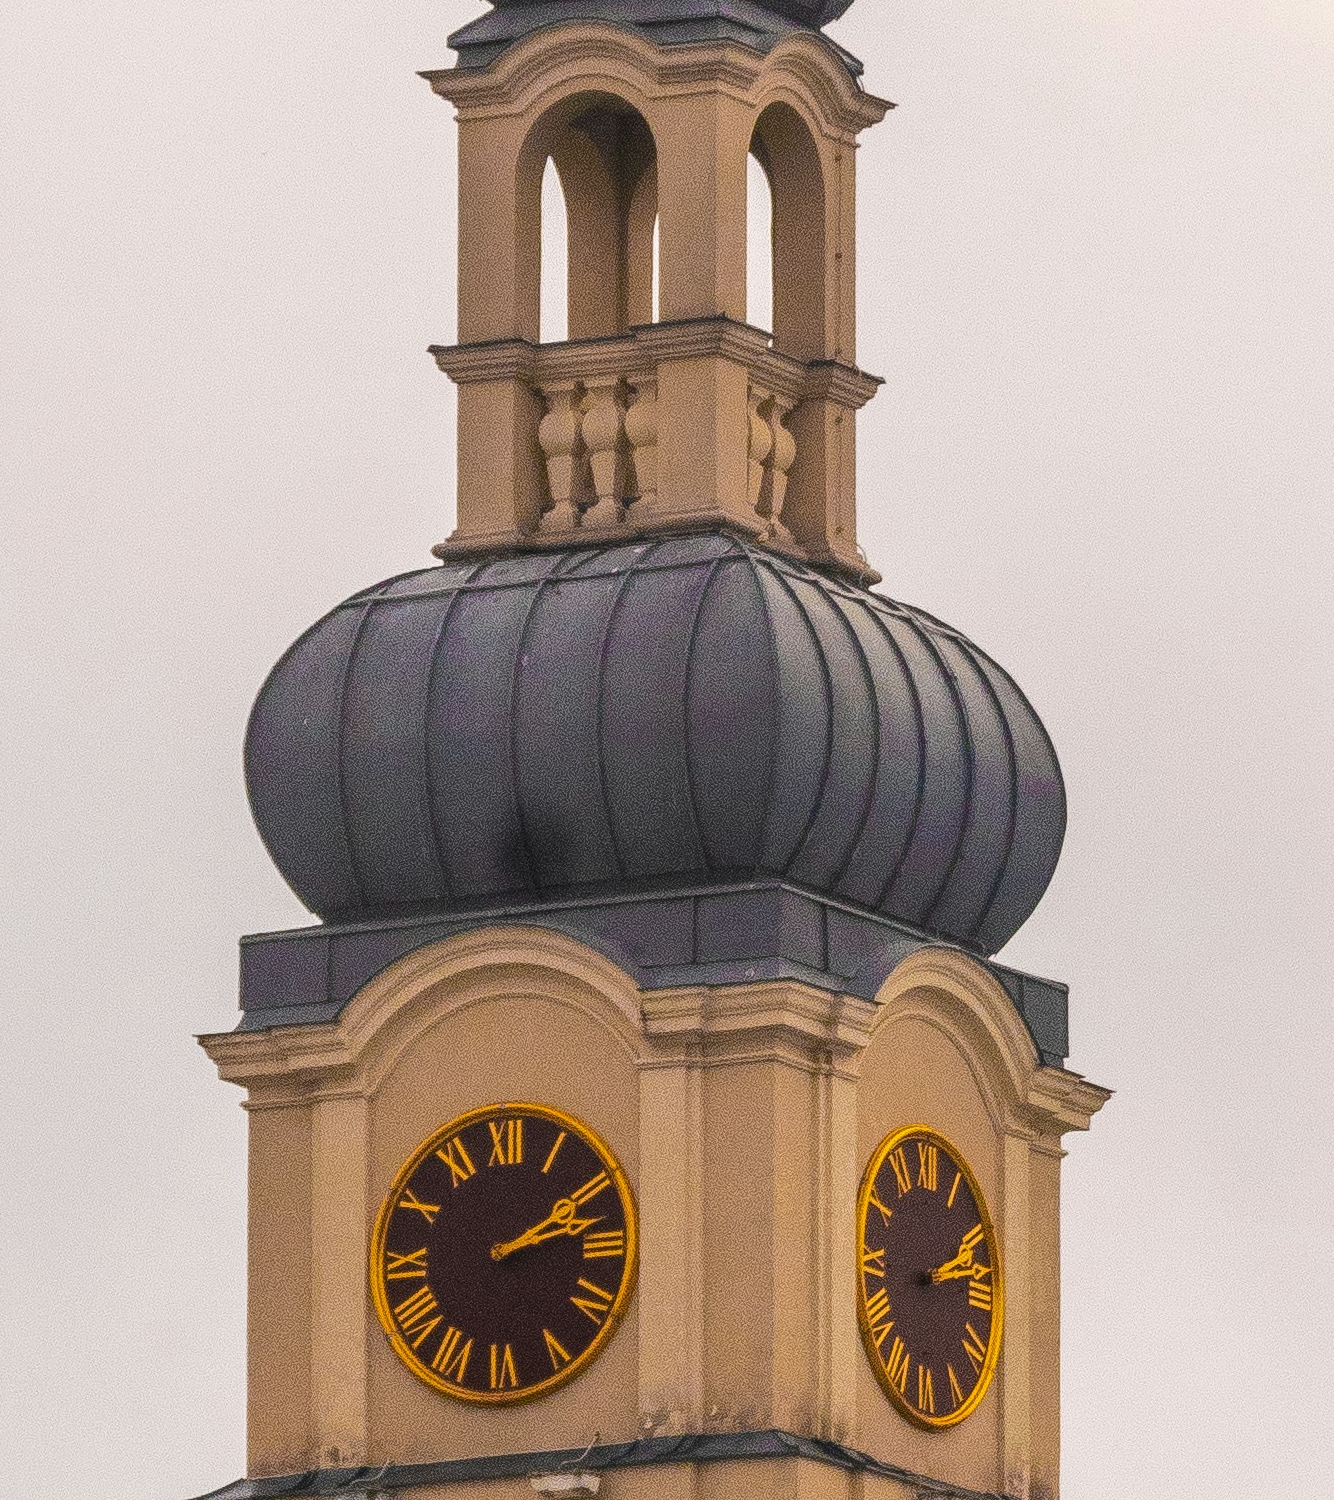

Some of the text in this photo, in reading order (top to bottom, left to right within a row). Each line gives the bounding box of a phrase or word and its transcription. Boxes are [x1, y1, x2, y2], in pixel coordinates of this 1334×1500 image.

[436, 1137, 477, 1189] XI
[488, 1119, 523, 1167] XII
[540, 1131, 567, 1174] I
[571, 1171, 611, 1205] II
[888, 1146, 912, 1199] XI
[917, 1142, 938, 1192] XII
[399, 1189, 441, 1224] X
[869, 1186, 893, 1228] X
[946, 1172, 962, 1209] I
[387, 1247, 428, 1280] IX
[583, 1230, 624, 1259] III
[863, 1245, 885, 1278] IX
[394, 1285, 444, 1349] VIII
[570, 1277, 614, 1325] IV
[867, 1287, 895, 1349] VIII
[968, 1280, 992, 1311] III
[431, 1326, 474, 1383] VII
[490, 1343, 519, 1389] VI
[543, 1328, 572, 1372] V
[886, 1335, 911, 1393] VII
[961, 1322, 987, 1375] IV
[918, 1364, 935, 1414] VI
[946, 1363, 965, 1408] V
